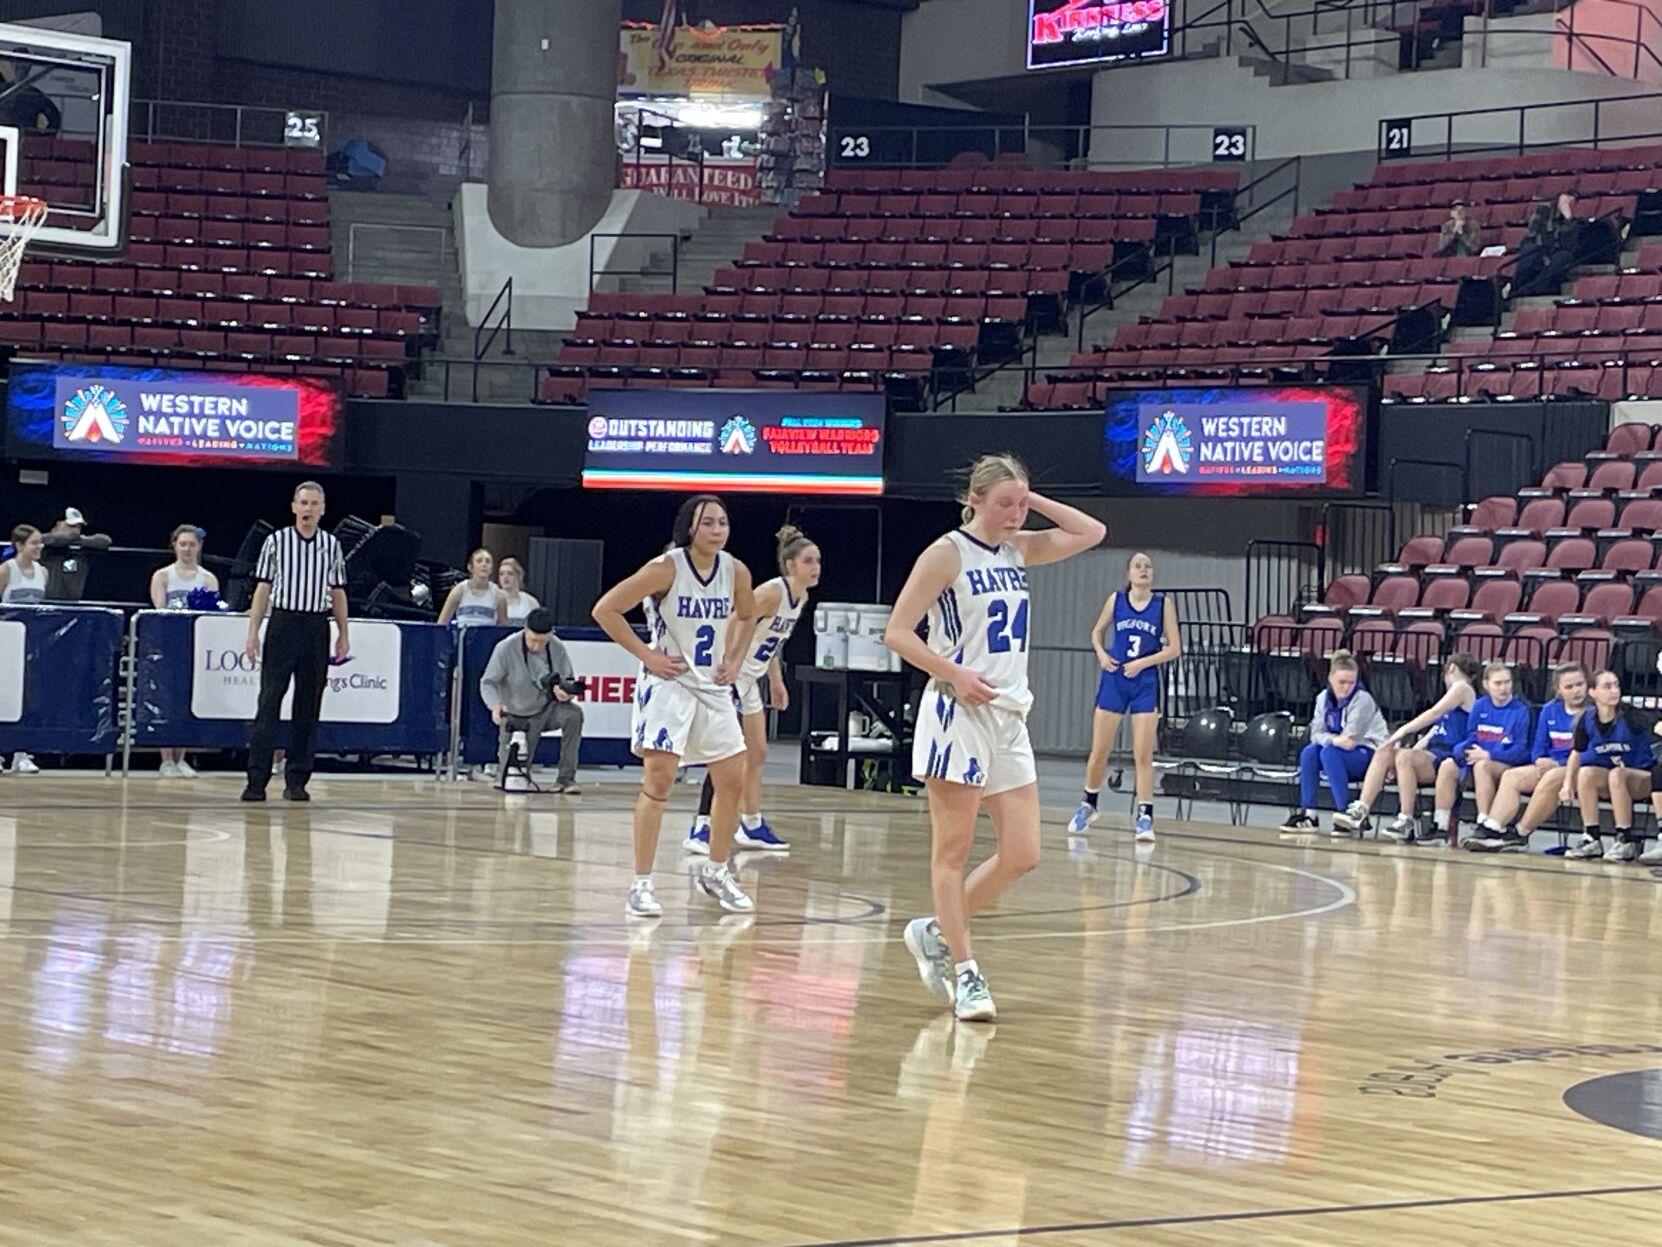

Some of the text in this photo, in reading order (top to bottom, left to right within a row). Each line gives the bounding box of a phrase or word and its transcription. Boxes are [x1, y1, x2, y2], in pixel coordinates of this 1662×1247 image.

[727, 38, 769, 56] Only
[287, 117, 318, 138] 25
[841, 136, 870, 157] 23
[1214, 134, 1245, 156] 23
[1389, 128, 1409, 150] 21
[139, 393, 249, 417] WESTERN
[137, 415, 295, 441] NATIVE VOICE
[608, 419, 715, 438] OUTSTANDING
[1200, 416, 1286, 437] WESTERN
[1199, 440, 1325, 462] NATIVE VOICE
[987, 599, 1029, 654] 24
[694, 624, 716, 667] 2
[1127, 634, 1142, 658] 3
[349, 673, 388, 690] Clinic
